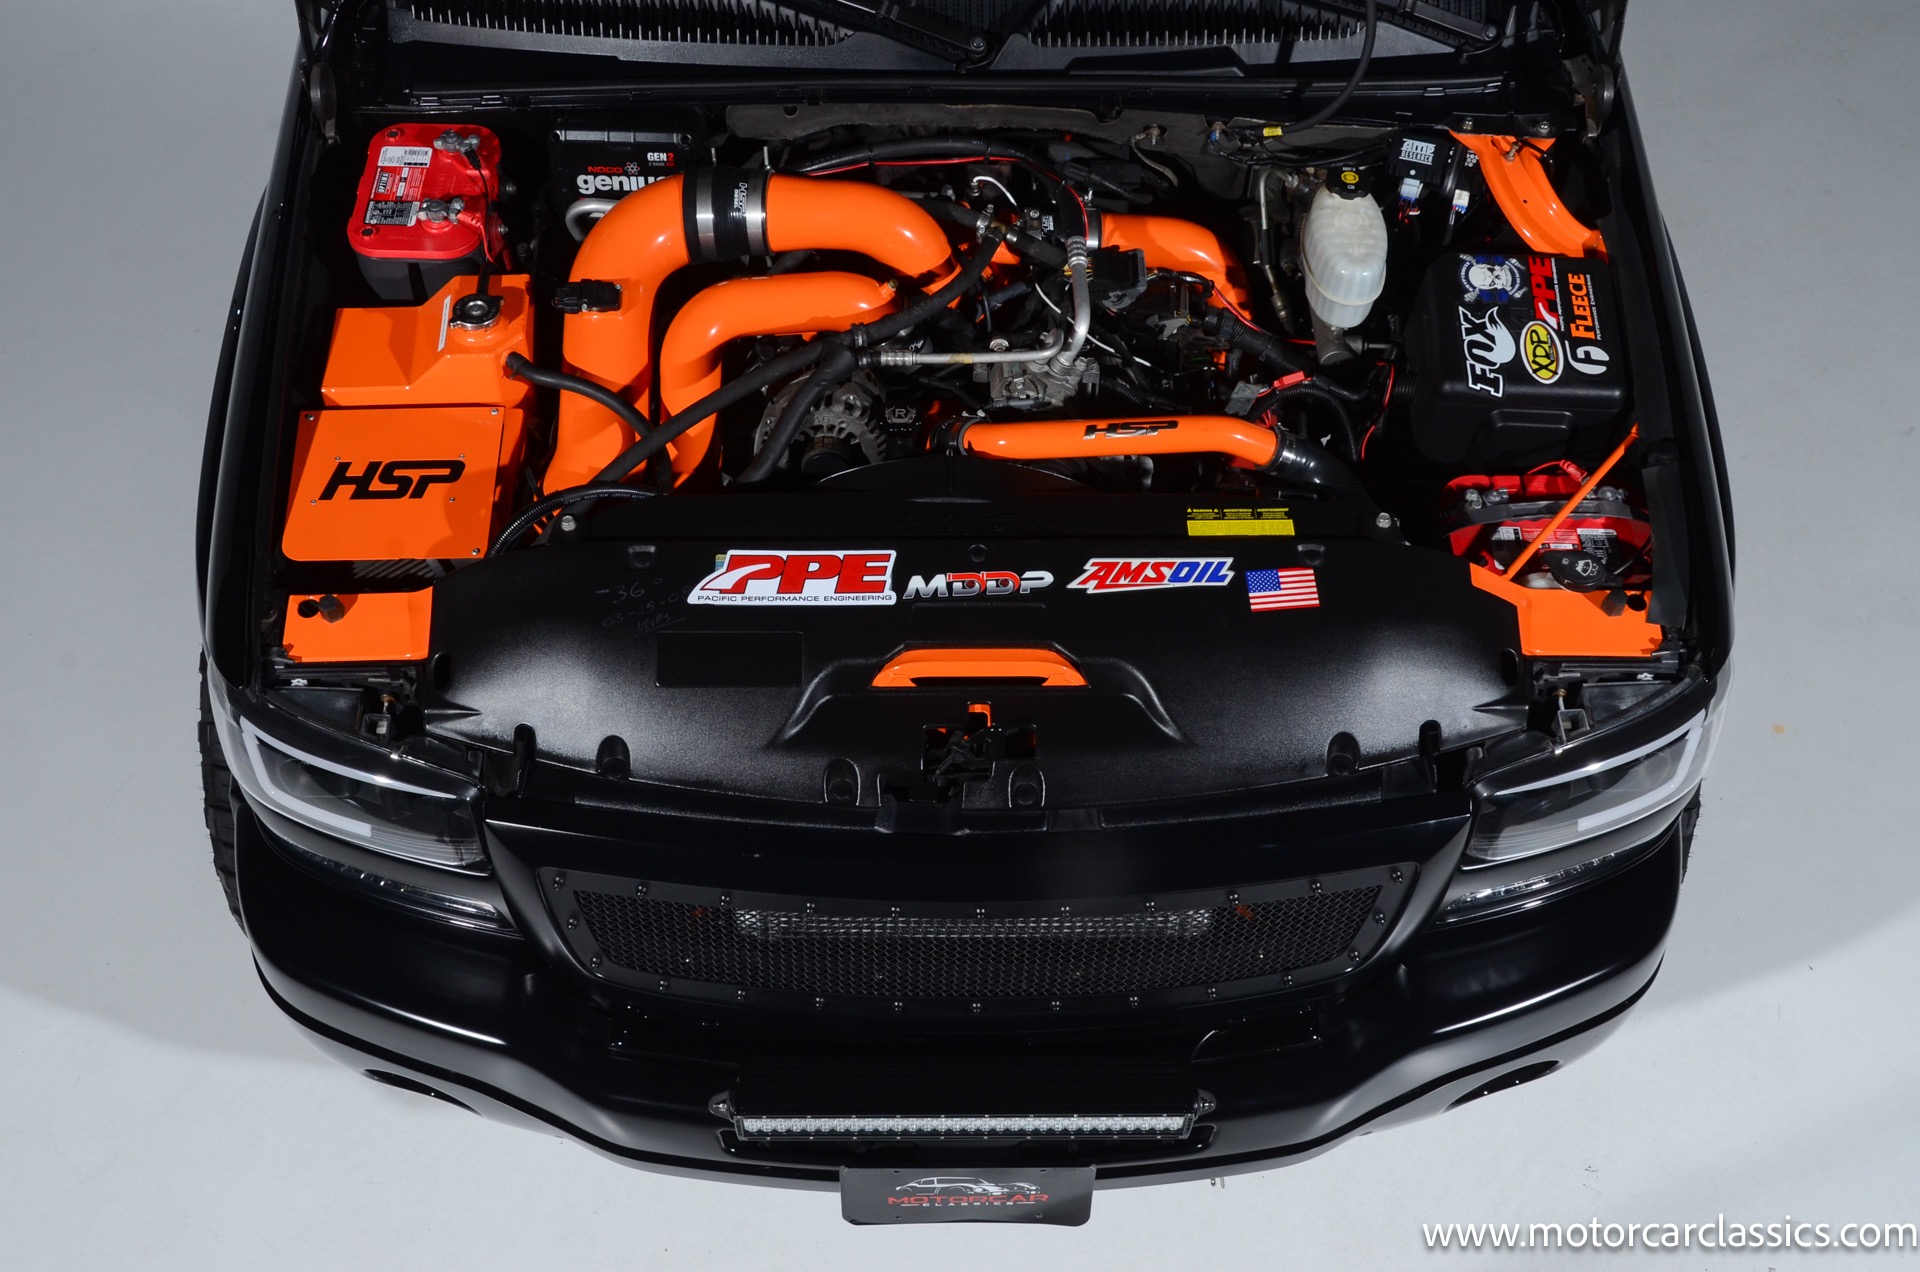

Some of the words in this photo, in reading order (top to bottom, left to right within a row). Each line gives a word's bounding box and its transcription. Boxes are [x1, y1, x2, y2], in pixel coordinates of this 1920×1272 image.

[577, 174, 667, 194] geniu
[1528, 256, 1560, 330] PPE
[1568, 273, 1596, 340] FLEECE
[1458, 306, 1516, 397] FOX
[1530, 329, 1559, 376] XDP
[1083, 420, 1179, 440] HSP
[318, 459, 466, 501] HSP
[700, 554, 891, 595] PPE
[903, 570, 1055, 600] MDDP
[1077, 561, 1230, 591] AMSOIL
[823, 594, 892, 602] ENGINEERING
[888, 1194, 1049, 1205] MOTORCAR
